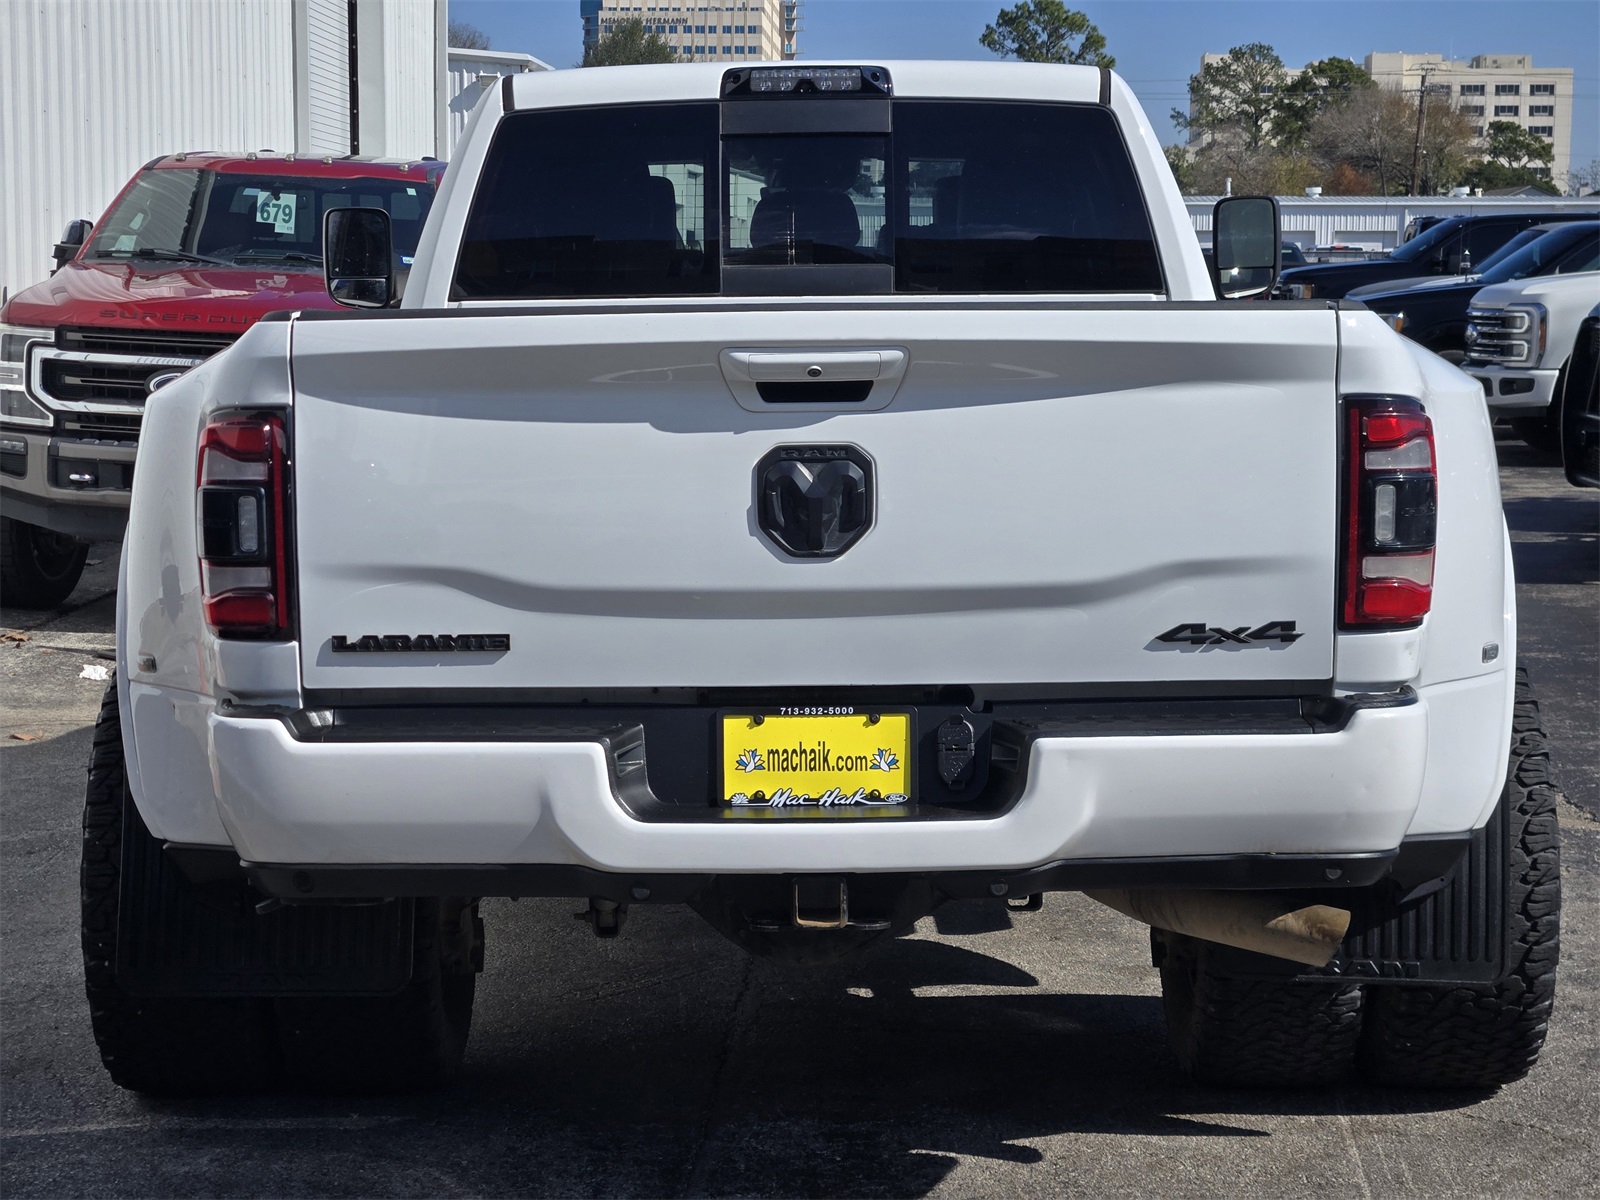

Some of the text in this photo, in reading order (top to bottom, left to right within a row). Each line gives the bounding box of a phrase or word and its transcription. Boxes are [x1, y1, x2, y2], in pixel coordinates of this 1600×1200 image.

[600, 17, 688, 25] MEMORI HERMANN
[260, 202, 293, 223] 679
[99, 309, 262, 325] SUPER DU
[780, 447, 849, 458] RAM
[331, 634, 510, 653] LARAMIE
[780, 706, 855, 716] 713-932-5000
[766, 741, 869, 773] machaik.com
[769, 786, 868, 807] Mac Haik
